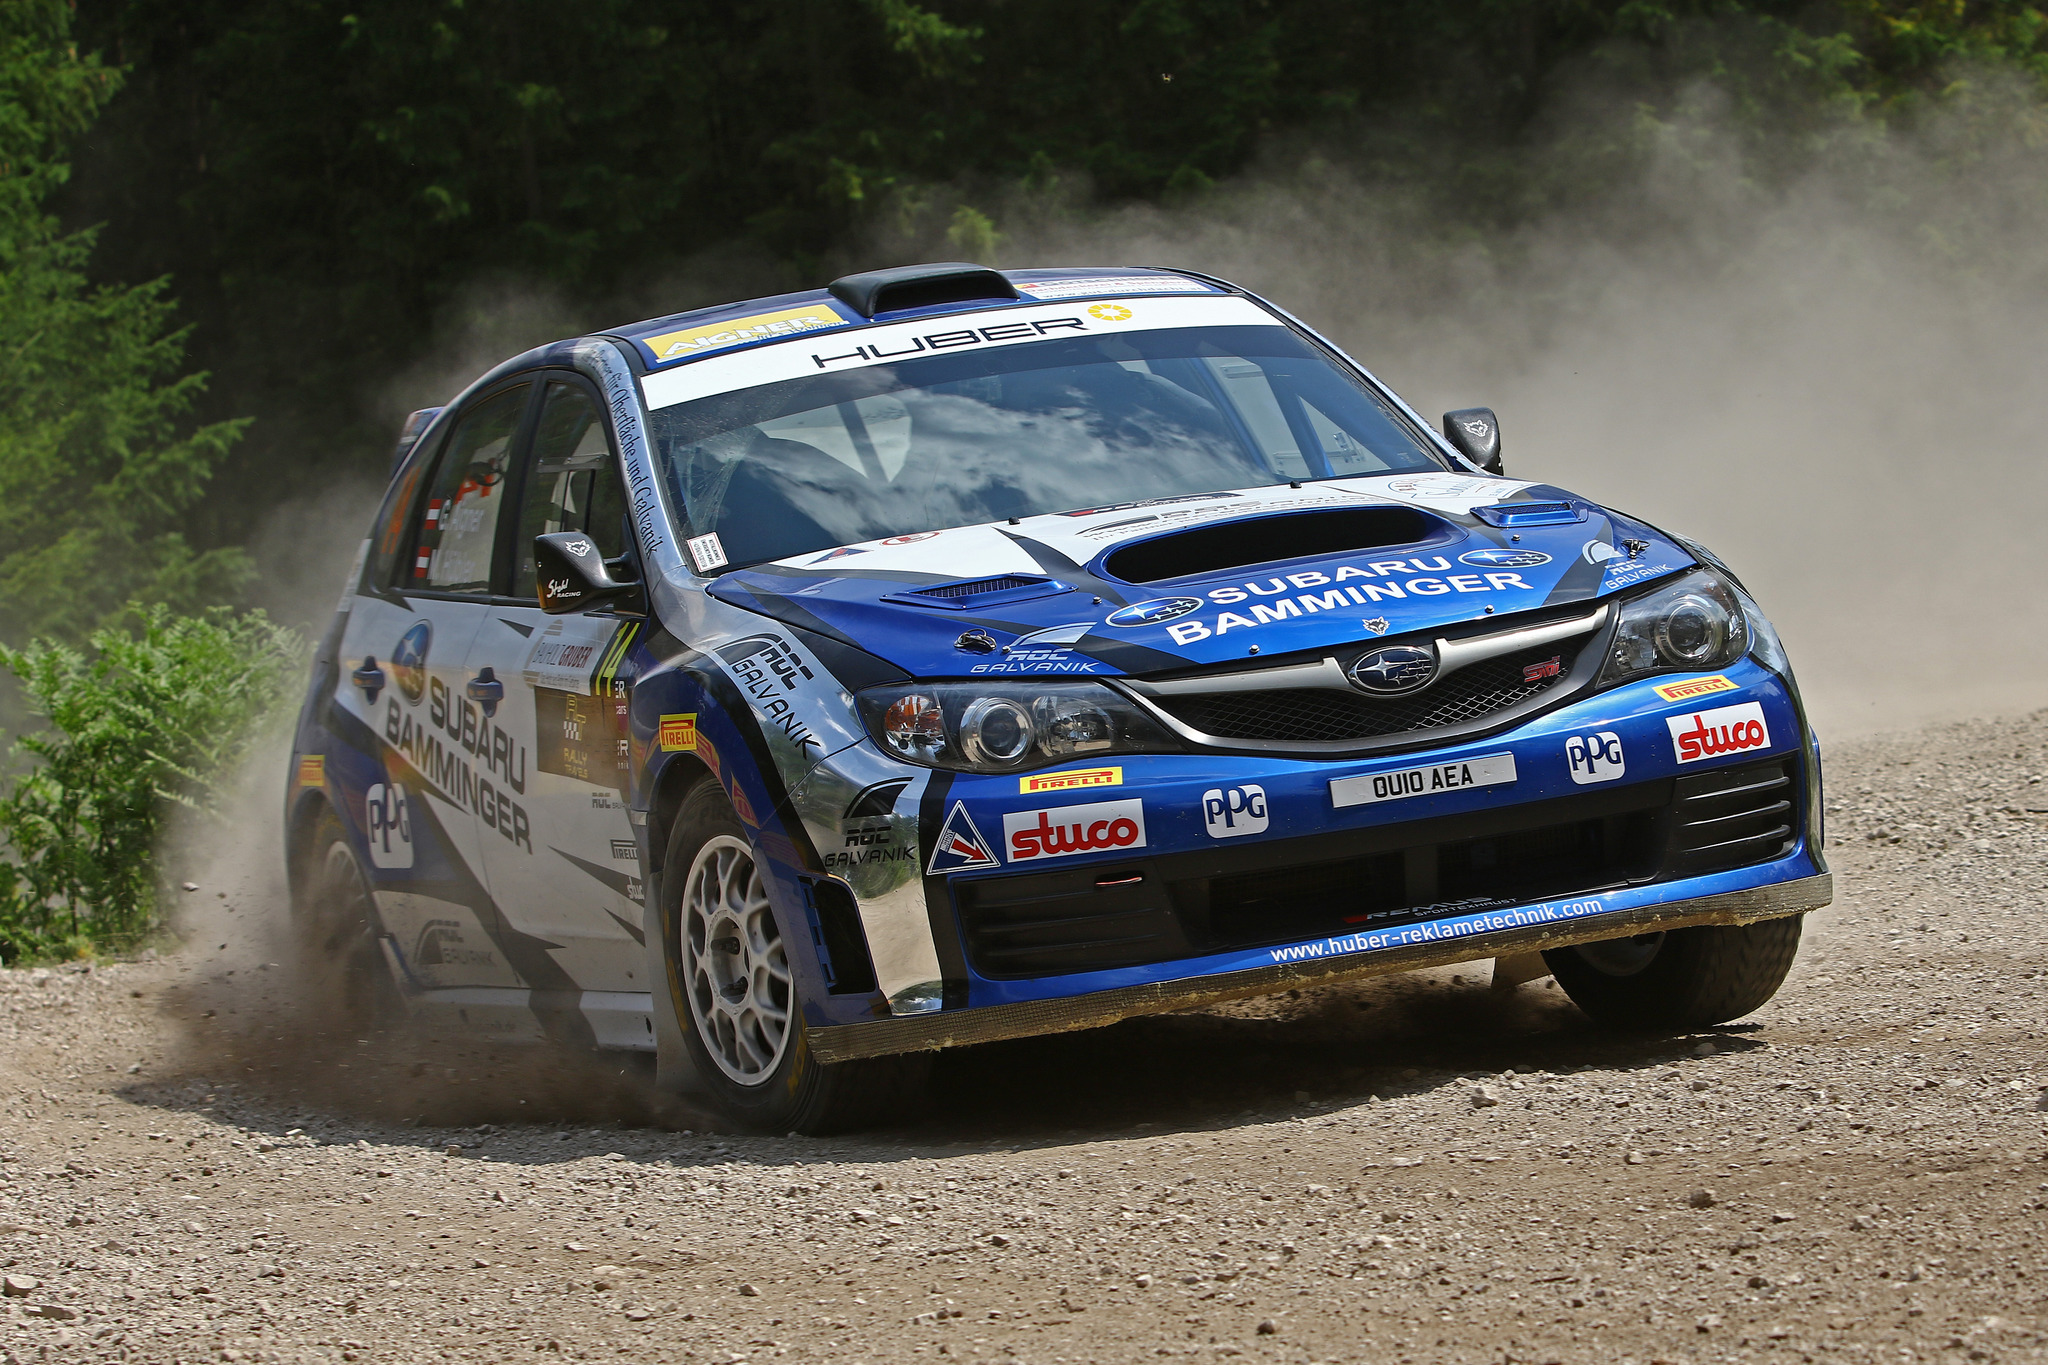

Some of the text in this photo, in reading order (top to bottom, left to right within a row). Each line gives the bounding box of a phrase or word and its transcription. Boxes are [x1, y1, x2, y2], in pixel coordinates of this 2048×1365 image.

[663, 315, 827, 356] AIGNER
[811, 317, 1090, 368] HUBER
[610, 388, 640, 461] Oberfläche
[626, 459, 649, 490] und
[634, 486, 663, 560] Galvanik
[1208, 560, 1452, 605] SUBARU
[1605, 563, 1675, 590] GALVANIK
[1165, 572, 1534, 647] BAMMINGER
[558, 644, 594, 669] GRUBER
[595, 621, 640, 697] 14
[970, 661, 1100, 674] GALVANIK
[1664, 677, 1731, 699] PIRELLI
[731, 659, 821, 761] GALVANIK
[430, 676, 525, 796] SUBARU
[662, 719, 695, 747] PIRELLI
[1678, 714, 1765, 761] stuco
[386, 696, 533, 856] BAMMINGER
[1431, 763, 1474, 790] AEA
[1569, 737, 1622, 775] PPG
[1029, 770, 1115, 791] PIRELLI
[371, 783, 410, 854] PPG
[1207, 786, 1266, 829] PPG
[610, 839, 639, 860] PIRELL
[824, 844, 917, 867] GALVANIK
[1011, 811, 1140, 861] stuco
[626, 876, 646, 900] stuc
[1366, 896, 1494, 921] REMUS
[1414, 897, 1518, 917] SPORTEXHAUST
[1270, 899, 1604, 964] www.huber-reklametechnik.com
